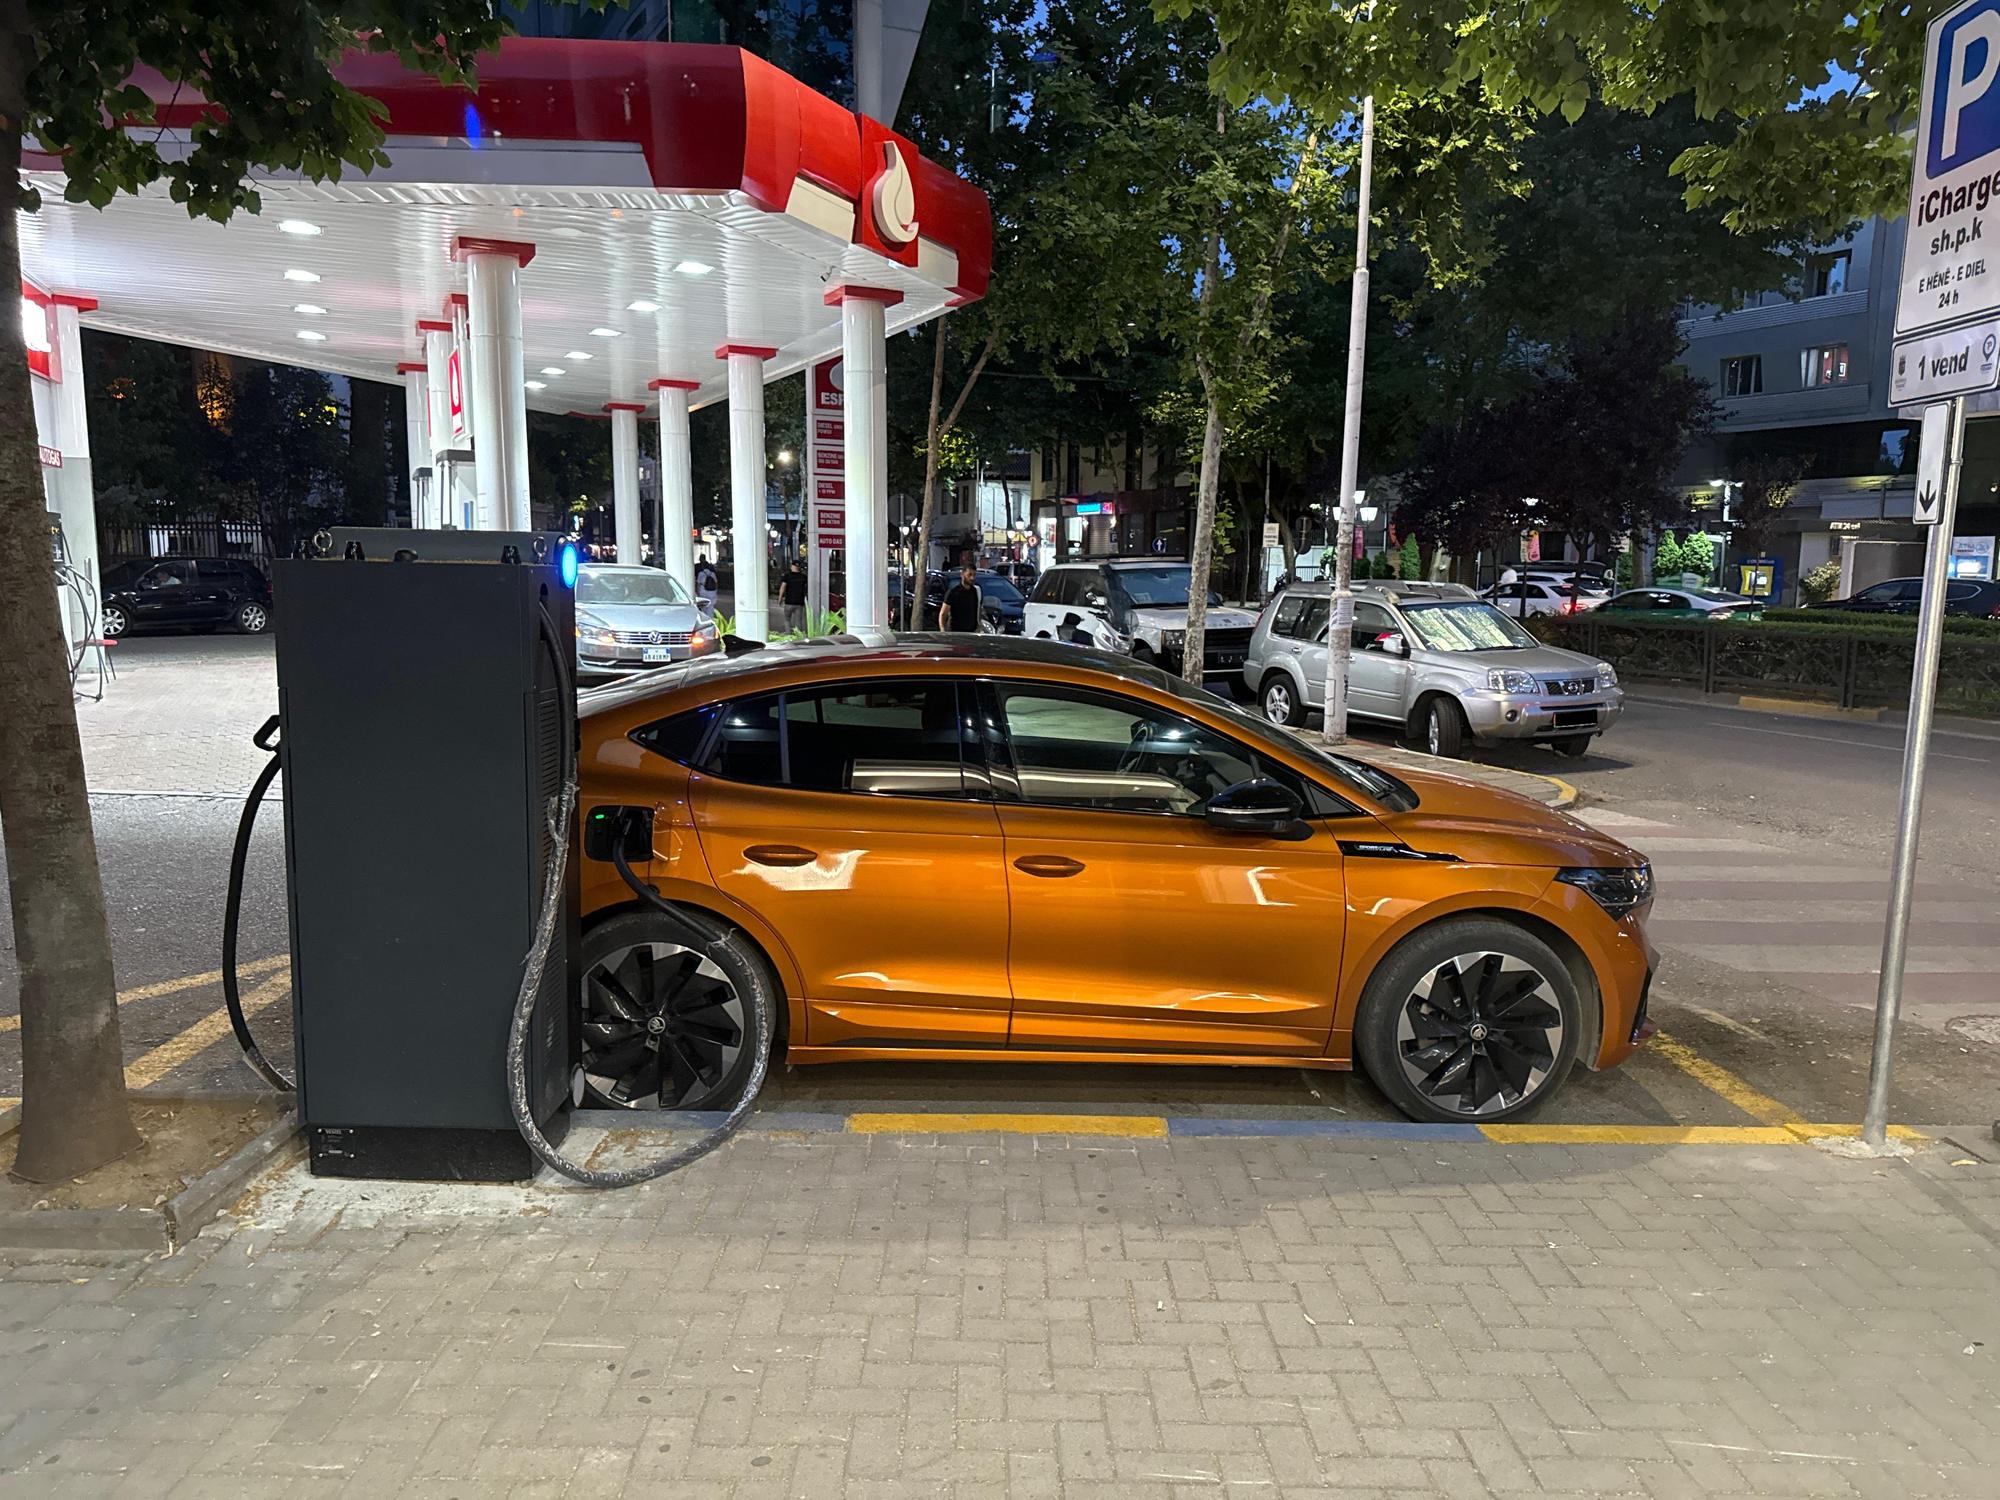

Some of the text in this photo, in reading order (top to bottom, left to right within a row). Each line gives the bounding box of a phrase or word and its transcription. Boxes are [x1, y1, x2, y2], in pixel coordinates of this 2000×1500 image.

[1941, 9, 2000, 161] P
[1931, 217, 1983, 255] sh.p.k
[1919, 278, 1925, 293] E
[1957, 266, 1963, 281] E
[1965, 259, 1986, 278] DIEL
[1938, 289, 1959, 308] 24 h
[1919, 346, 1969, 380] 1 vend
